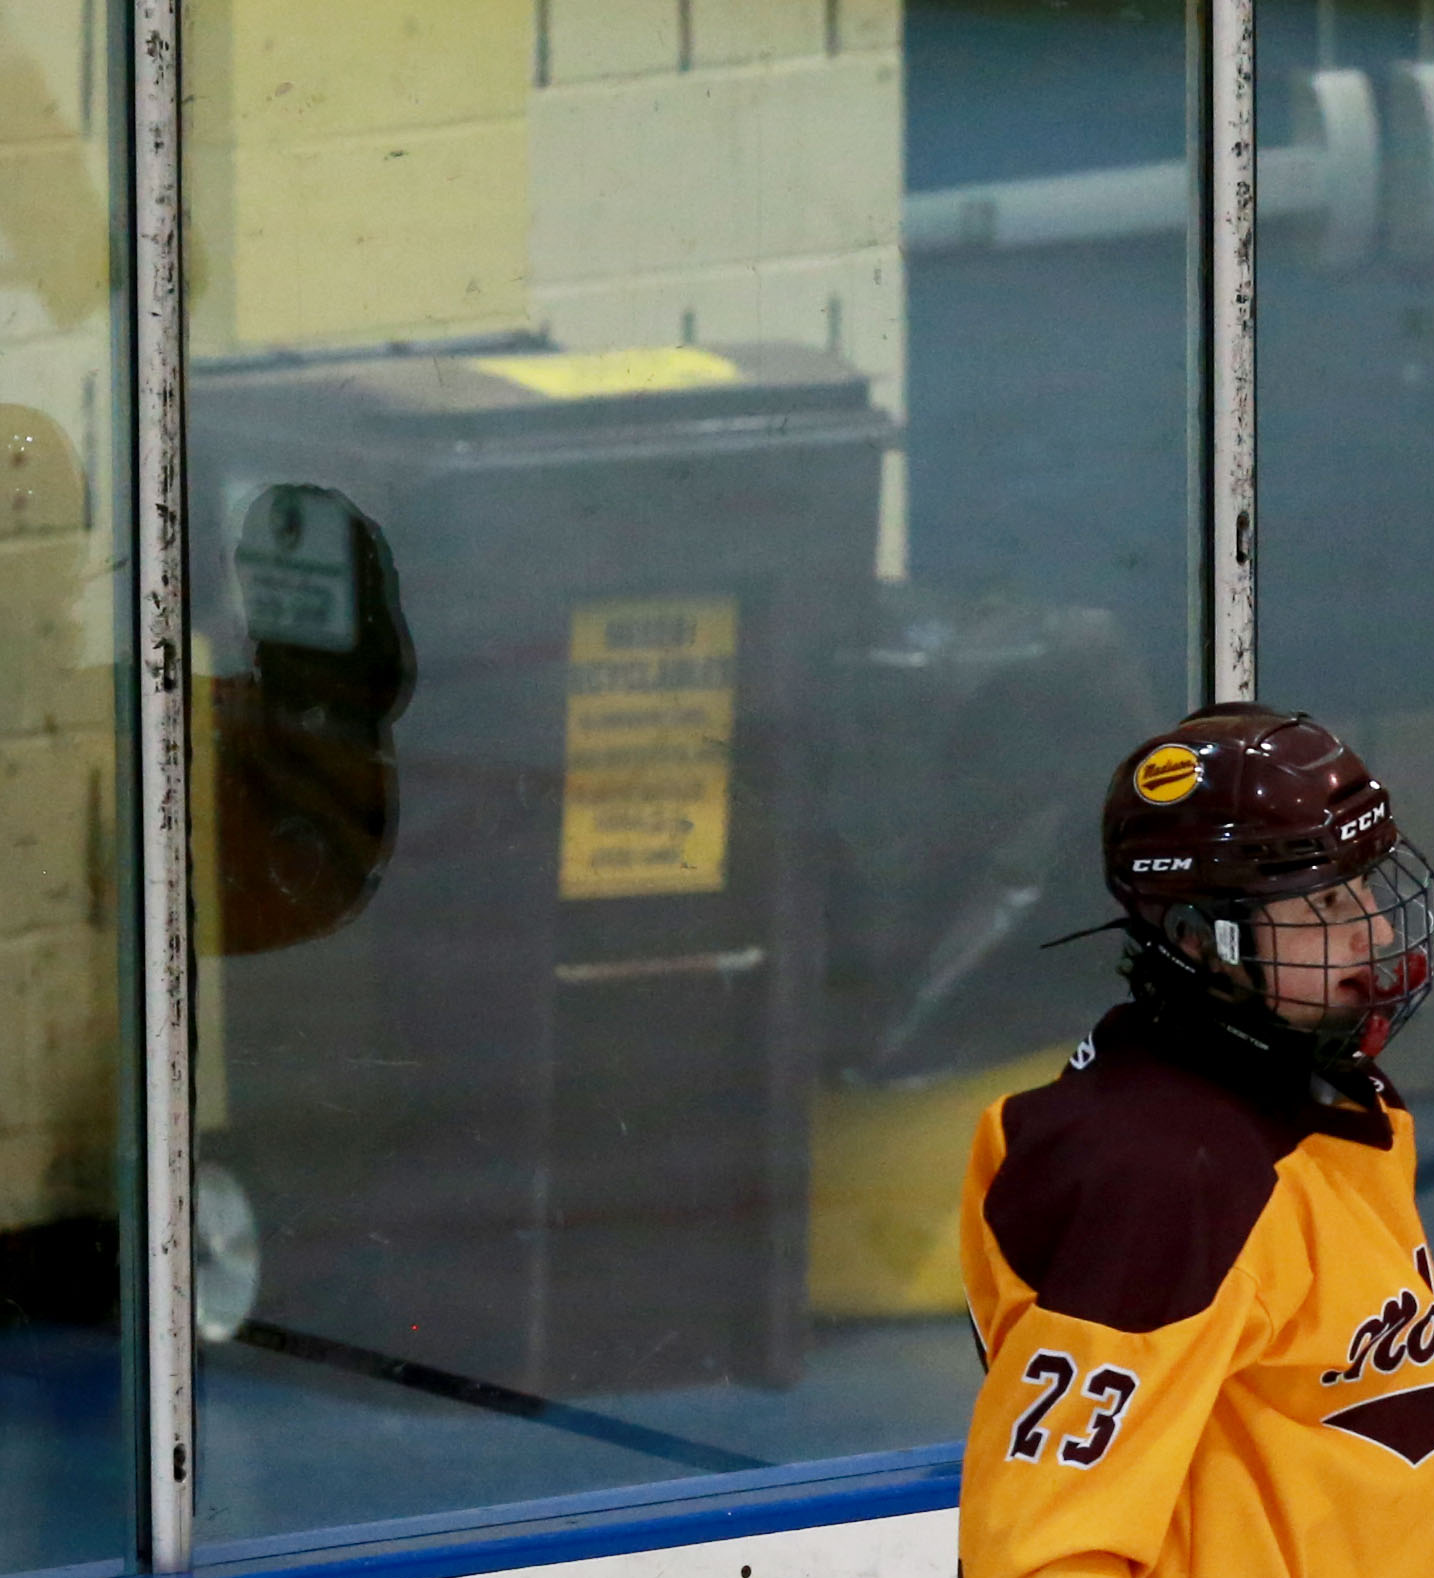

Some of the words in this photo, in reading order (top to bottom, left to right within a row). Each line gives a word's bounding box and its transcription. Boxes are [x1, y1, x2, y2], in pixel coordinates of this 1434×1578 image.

[1340, 802, 1386, 841] CCM
[1132, 857, 1193, 872] CCM
[1004, 1348, 1140, 1470] 23
